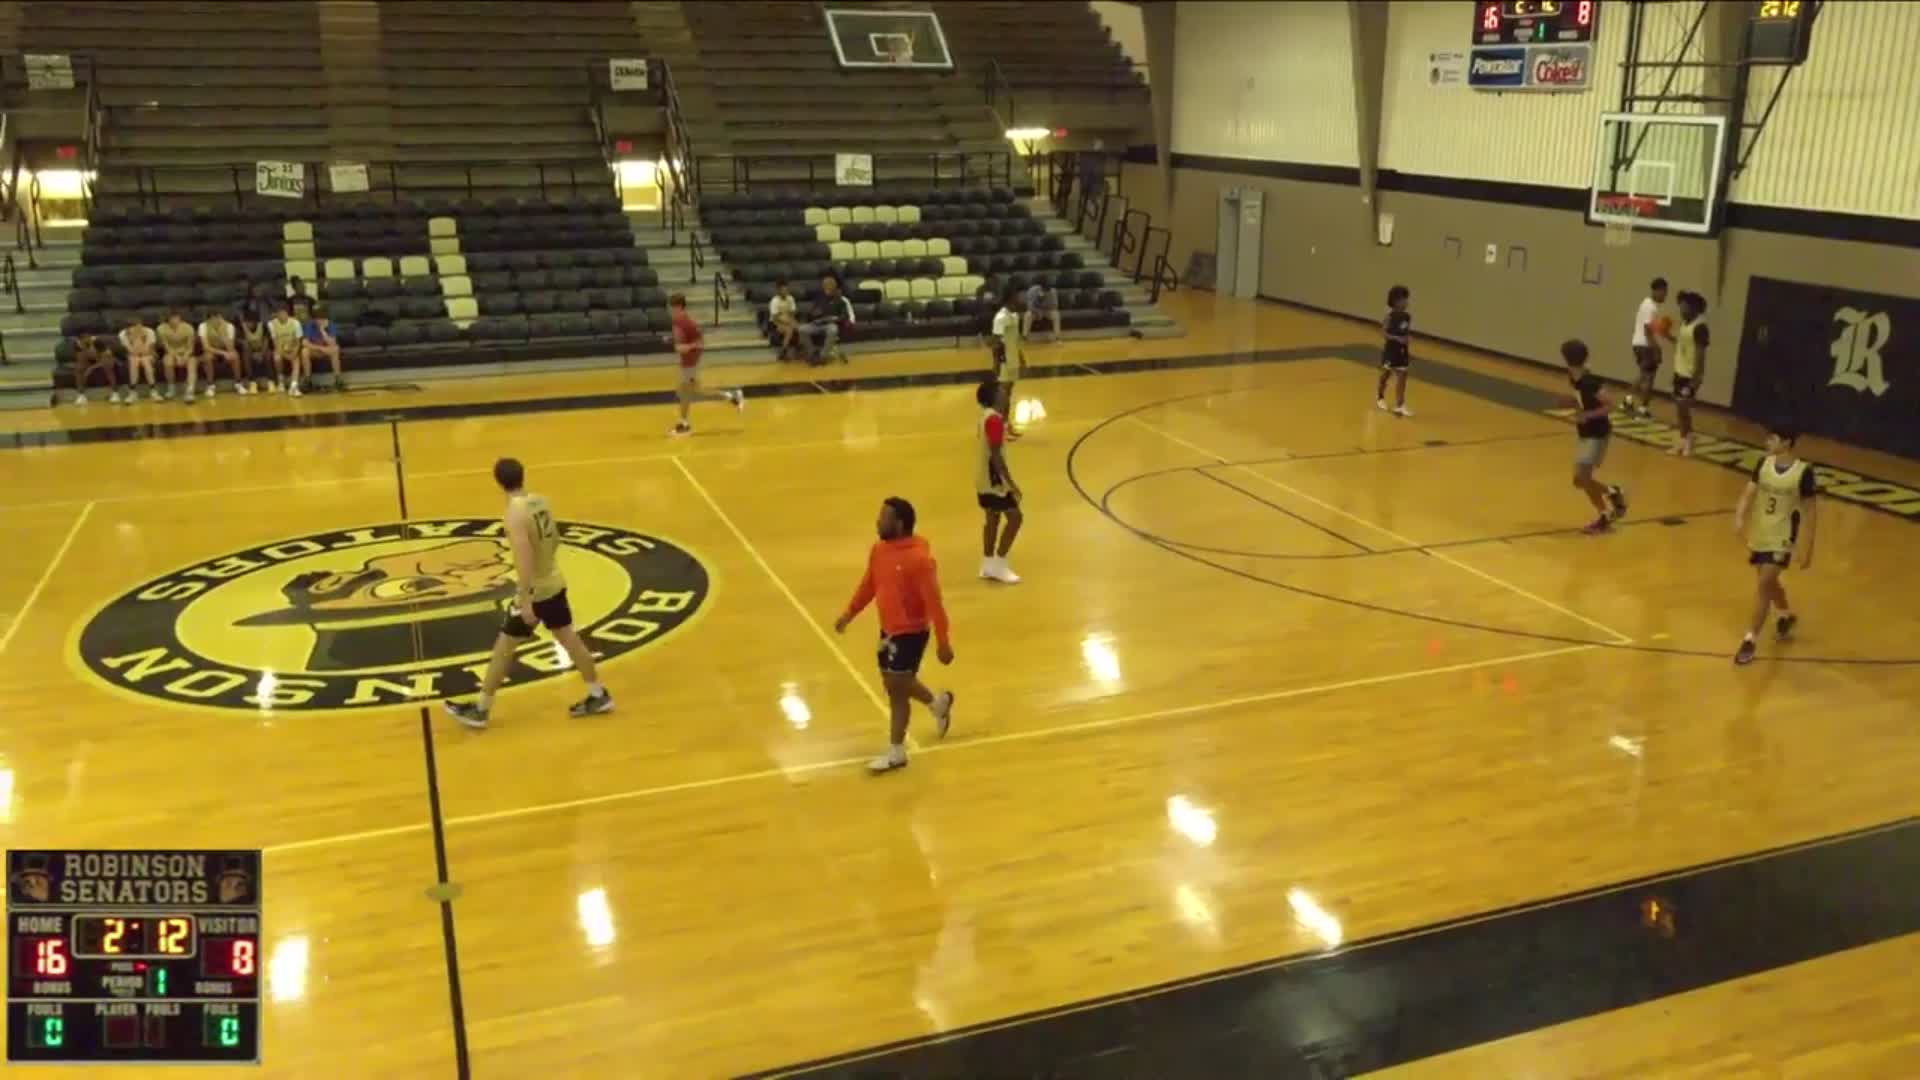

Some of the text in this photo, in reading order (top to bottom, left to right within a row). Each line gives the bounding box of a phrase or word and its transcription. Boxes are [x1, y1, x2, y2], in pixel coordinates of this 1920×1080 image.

[1484, 6, 1499, 29] 16
[1828, 307, 1891, 397] R
[1765, 496, 1777, 515] 3
[533, 510, 552, 540] 12
